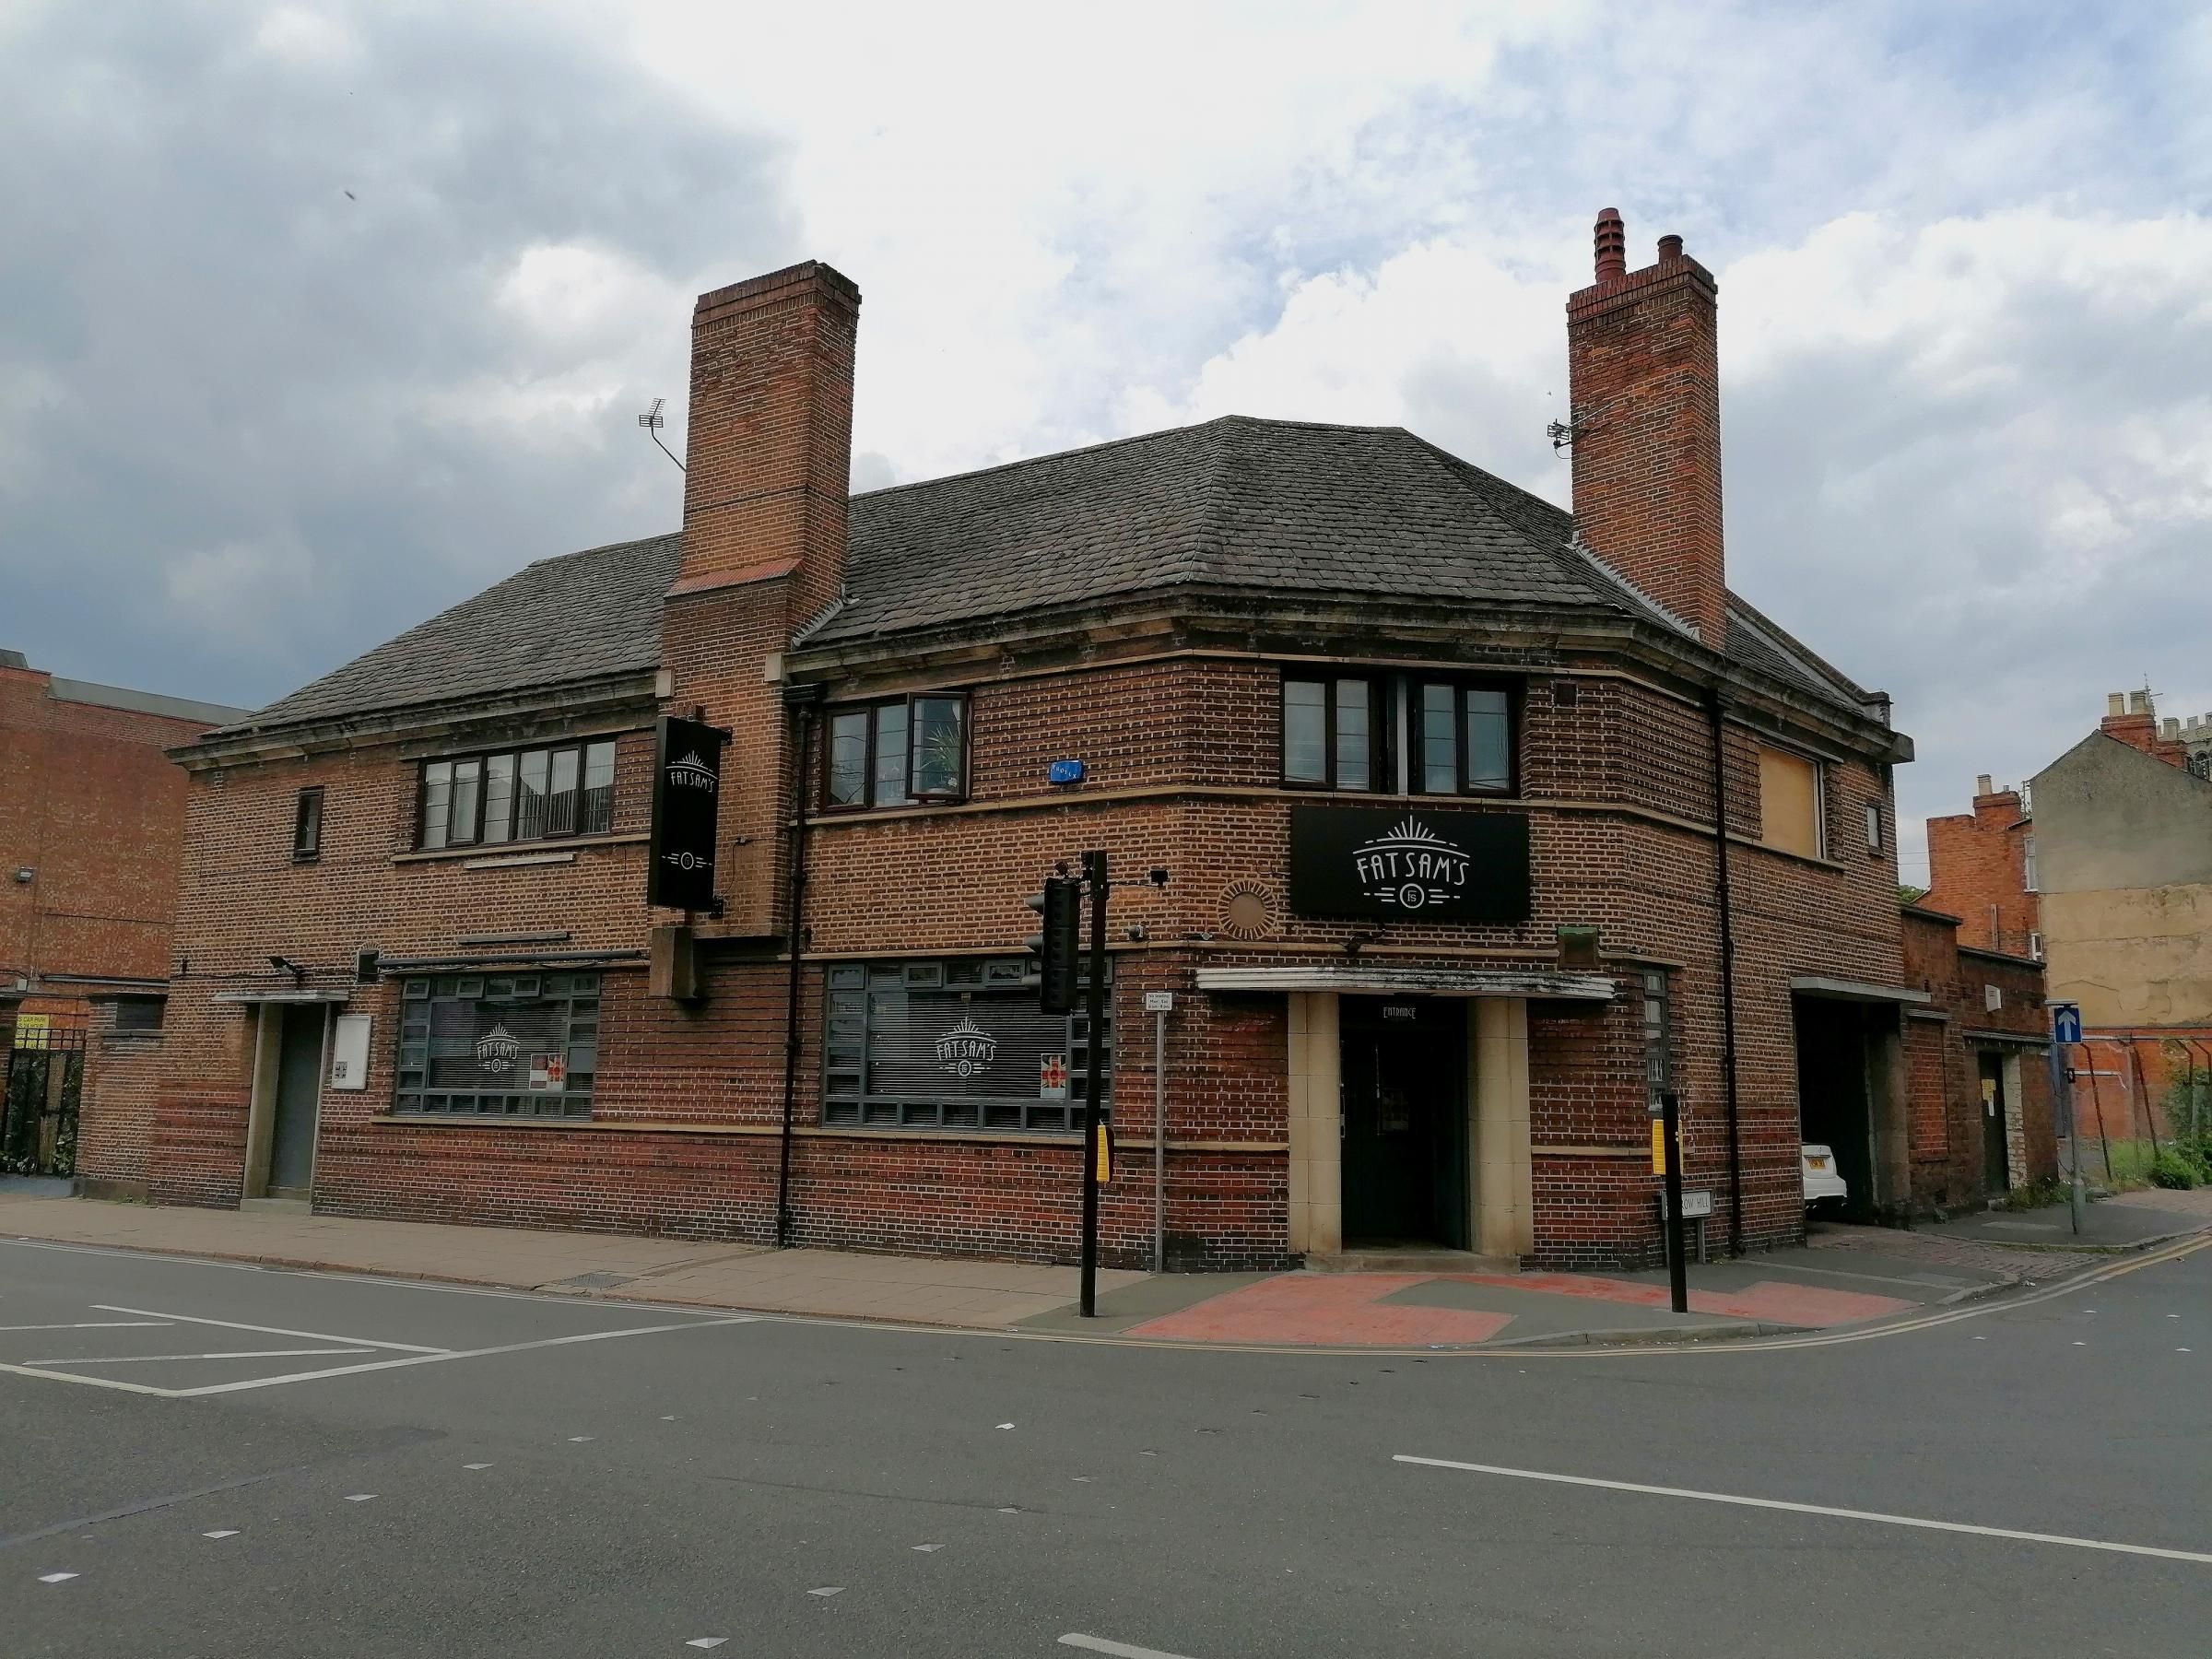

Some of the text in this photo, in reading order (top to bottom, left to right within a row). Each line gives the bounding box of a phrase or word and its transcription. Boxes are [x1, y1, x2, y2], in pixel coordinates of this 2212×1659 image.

[671, 771, 714, 793] FAT SAM'S
[1357, 852, 1470, 886] FAT SAM'S
[1383, 1006, 1417, 1019] ENTRANCE
[477, 1041, 520, 1060] FAT SAM'S
[936, 1040, 996, 1061] FAT SAM'S
[1681, 1196, 1709, 1209] OW HILL
